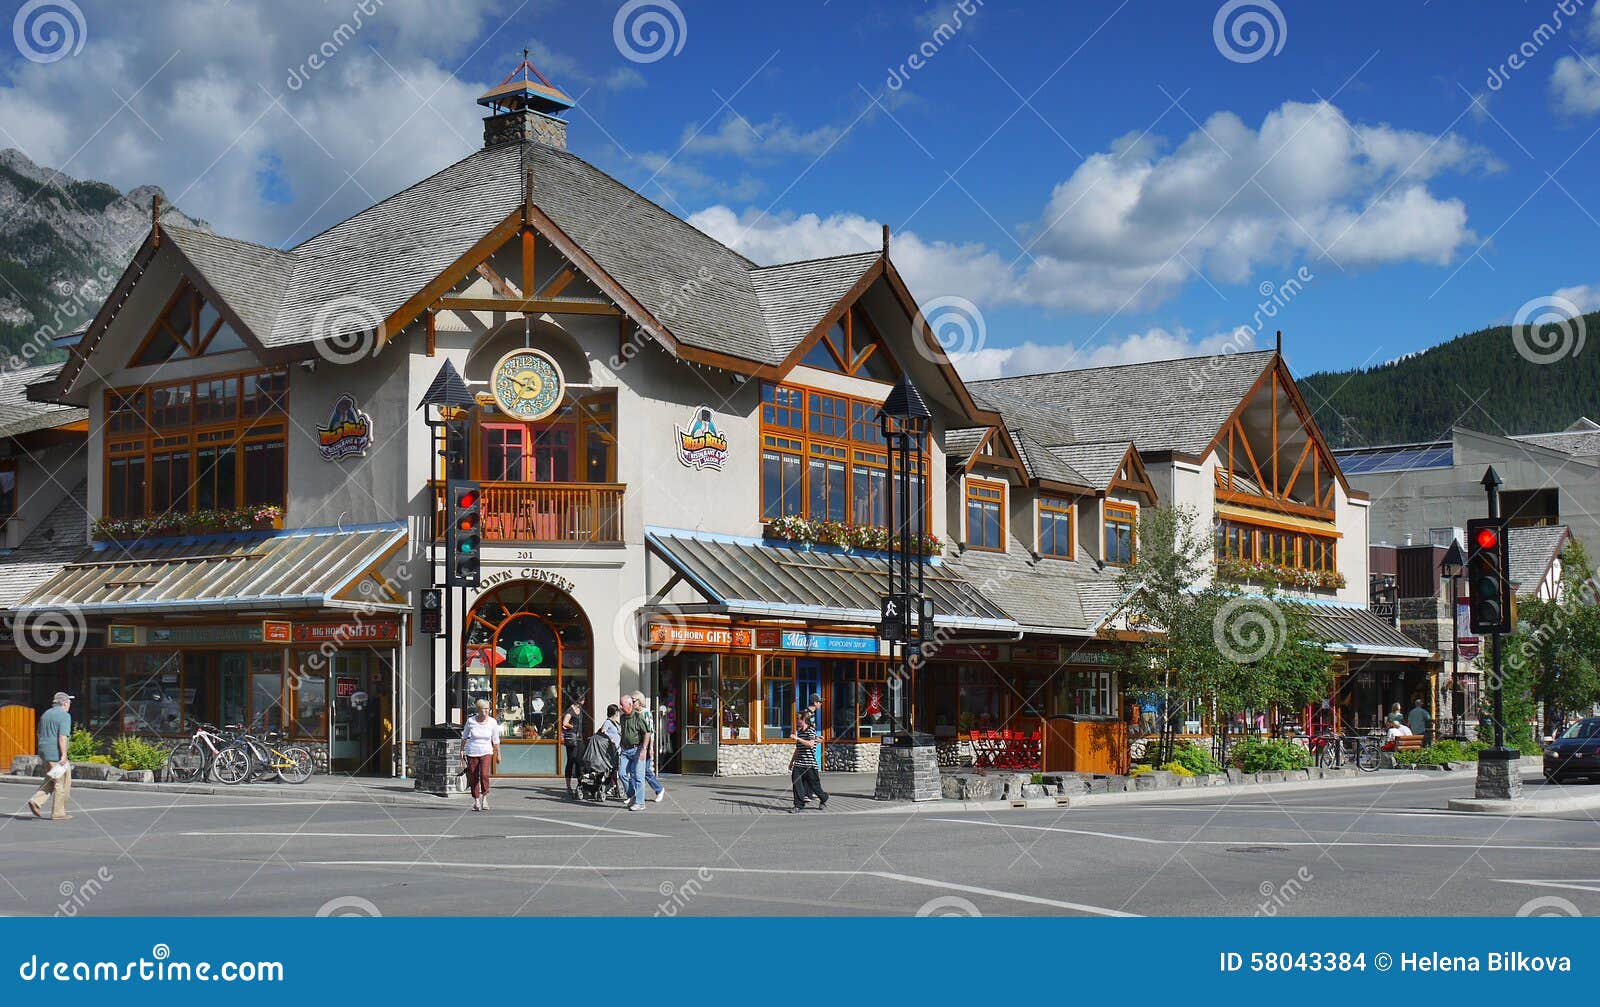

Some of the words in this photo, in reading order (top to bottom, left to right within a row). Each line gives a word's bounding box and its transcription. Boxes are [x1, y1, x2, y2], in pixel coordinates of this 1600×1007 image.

[522, 357, 533, 366] 12
[470, 569, 513, 595] TOWN
[520, 568, 575, 593] CENTRE
[312, 627, 324, 636] BIG
[325, 627, 346, 636] HORN
[348, 625, 377, 637] GIFTS
[671, 630, 683, 639] BIG
[684, 631, 704, 640] HORN
[706, 631, 733, 643] GIFTS
